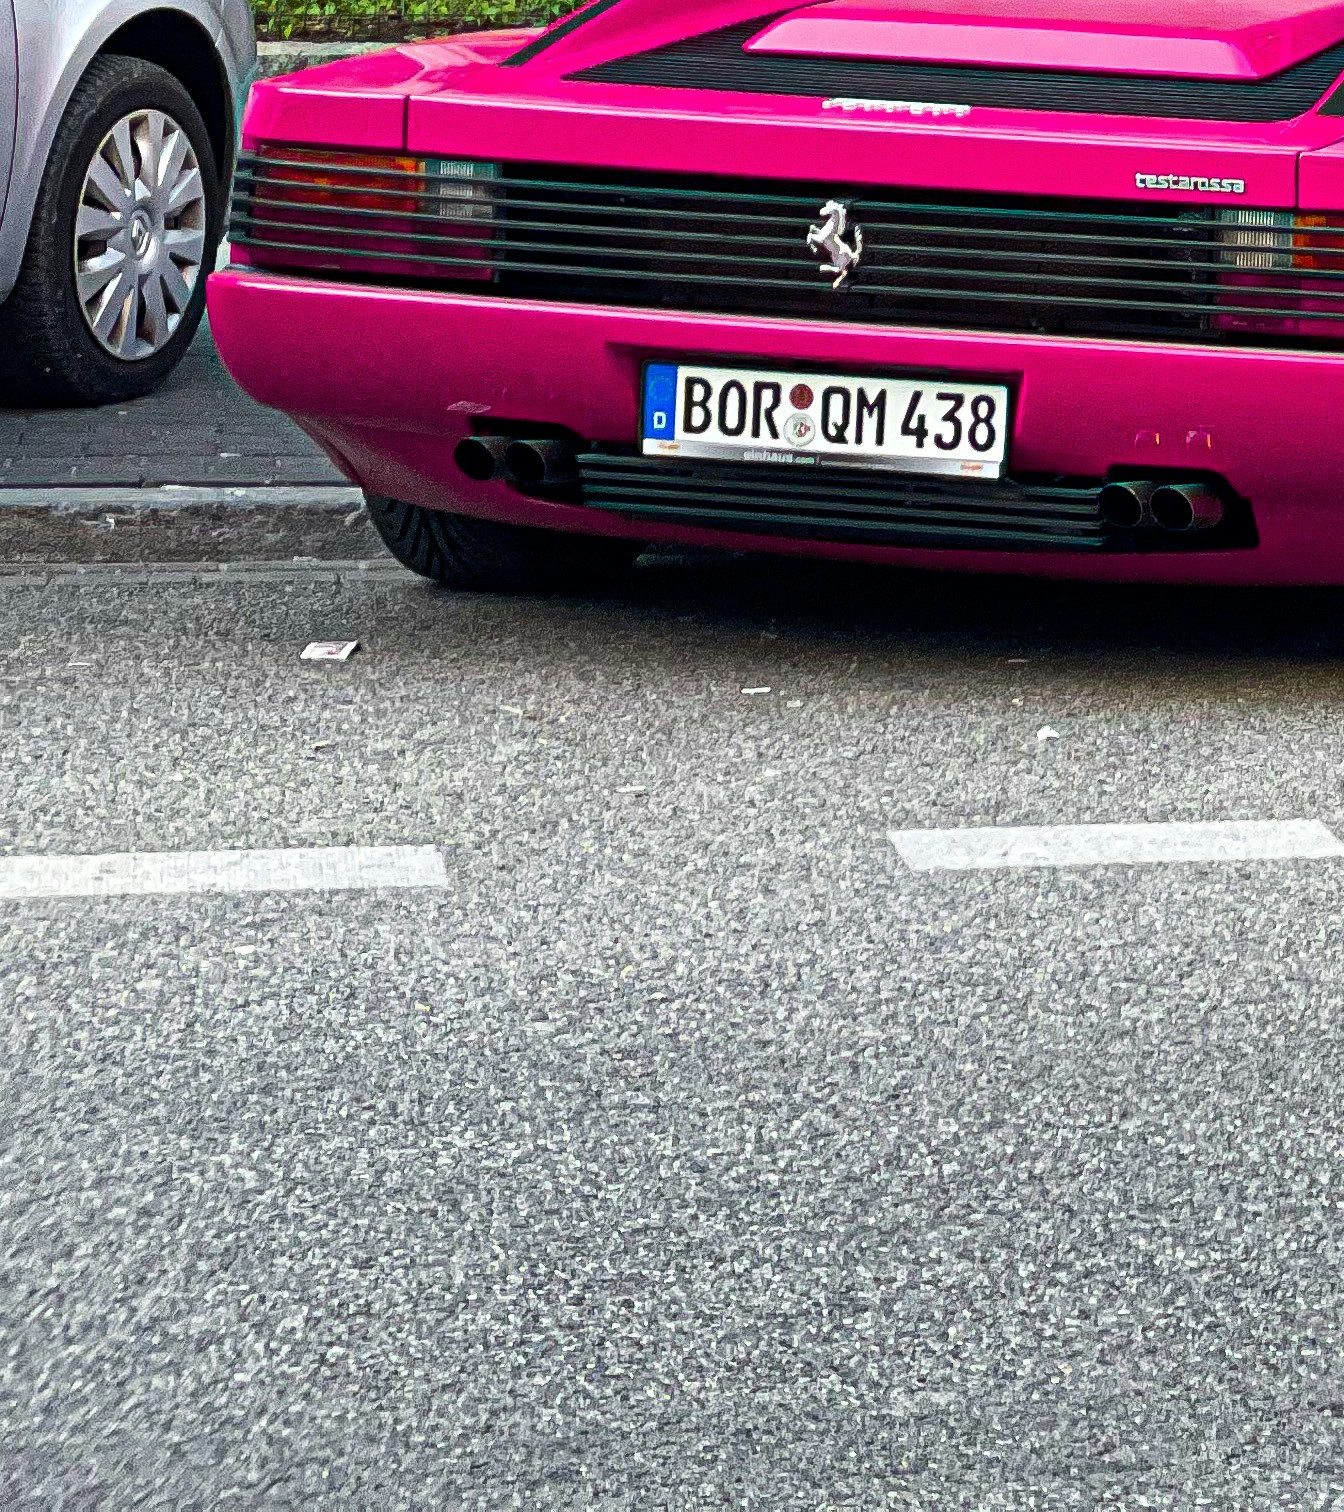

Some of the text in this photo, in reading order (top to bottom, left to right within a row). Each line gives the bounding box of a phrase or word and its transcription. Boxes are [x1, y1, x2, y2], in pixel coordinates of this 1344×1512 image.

[1135, 172, 1245, 193] testarossa
[653, 411, 667, 429] D
[682, 375, 997, 452] BOR QM 438
